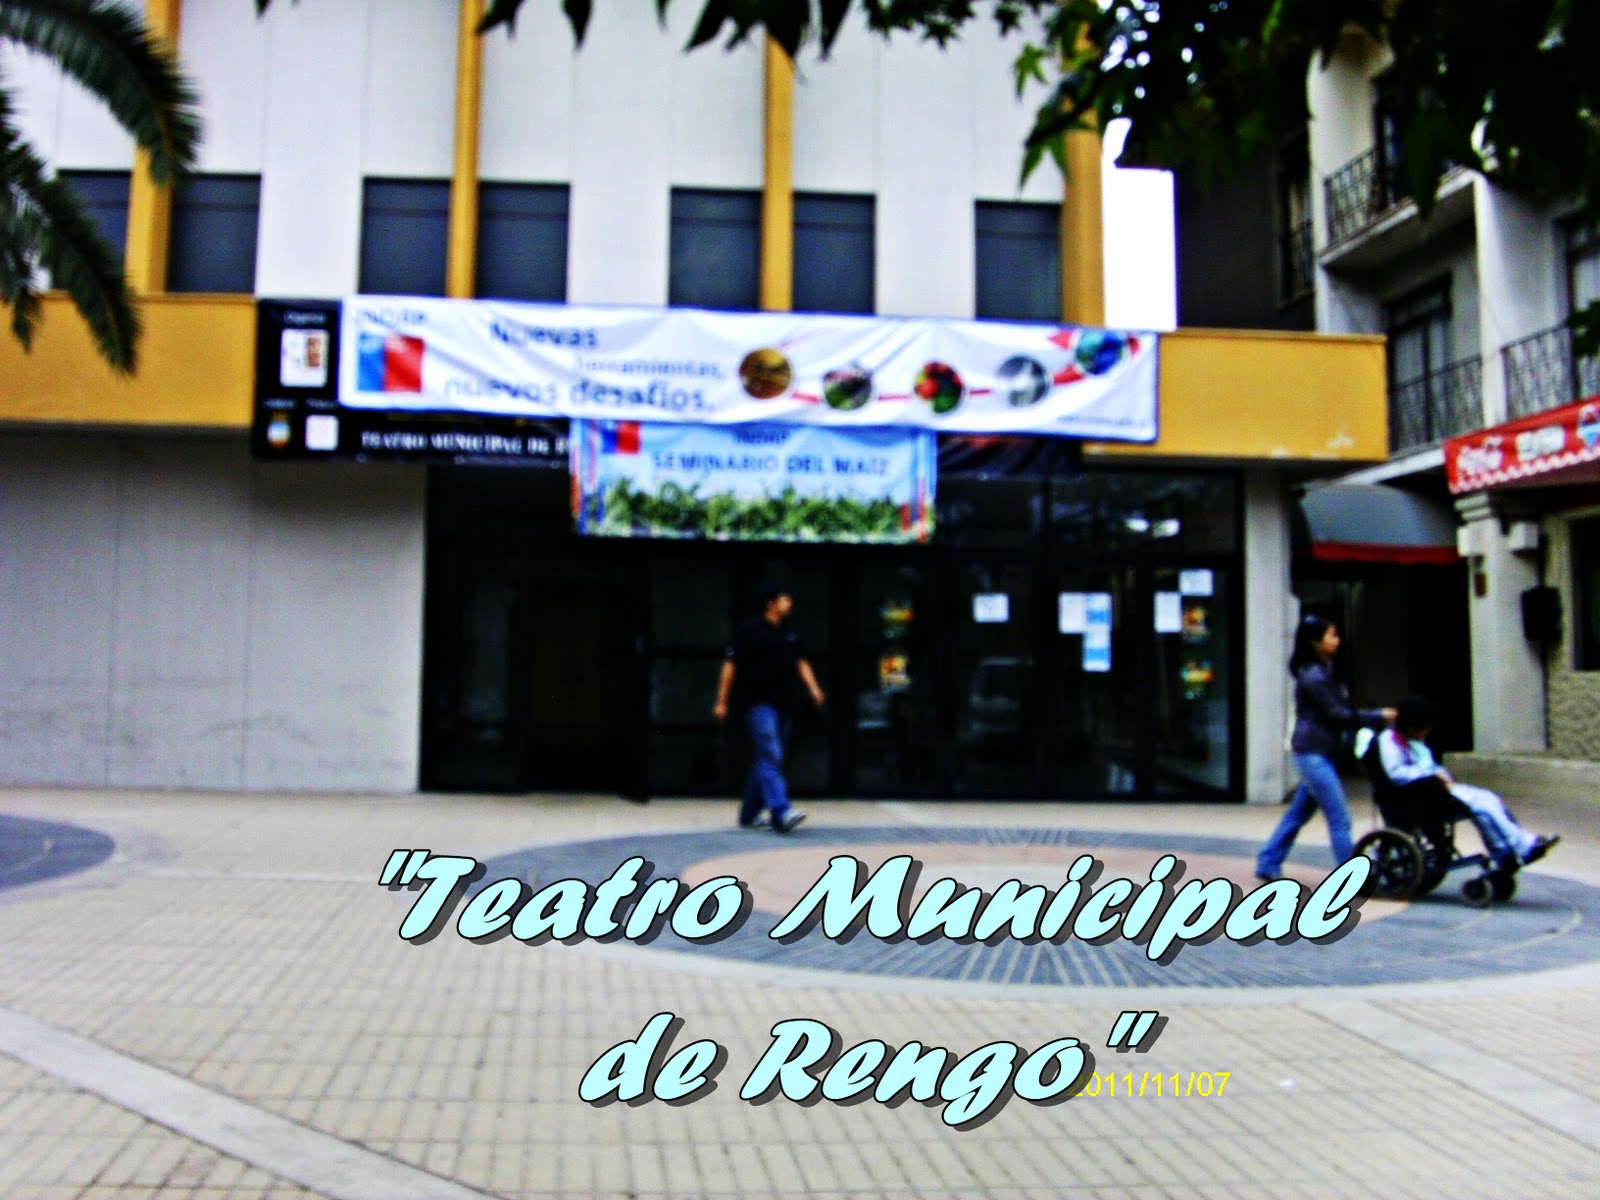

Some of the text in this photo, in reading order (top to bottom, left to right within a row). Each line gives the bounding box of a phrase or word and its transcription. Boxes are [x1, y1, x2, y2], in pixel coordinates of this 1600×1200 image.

[489, 321, 599, 350] Nuevas
[361, 431, 428, 449] TEATRO
[652, 451, 780, 475] SEMINARIO
[784, 453, 823, 475] DEL
